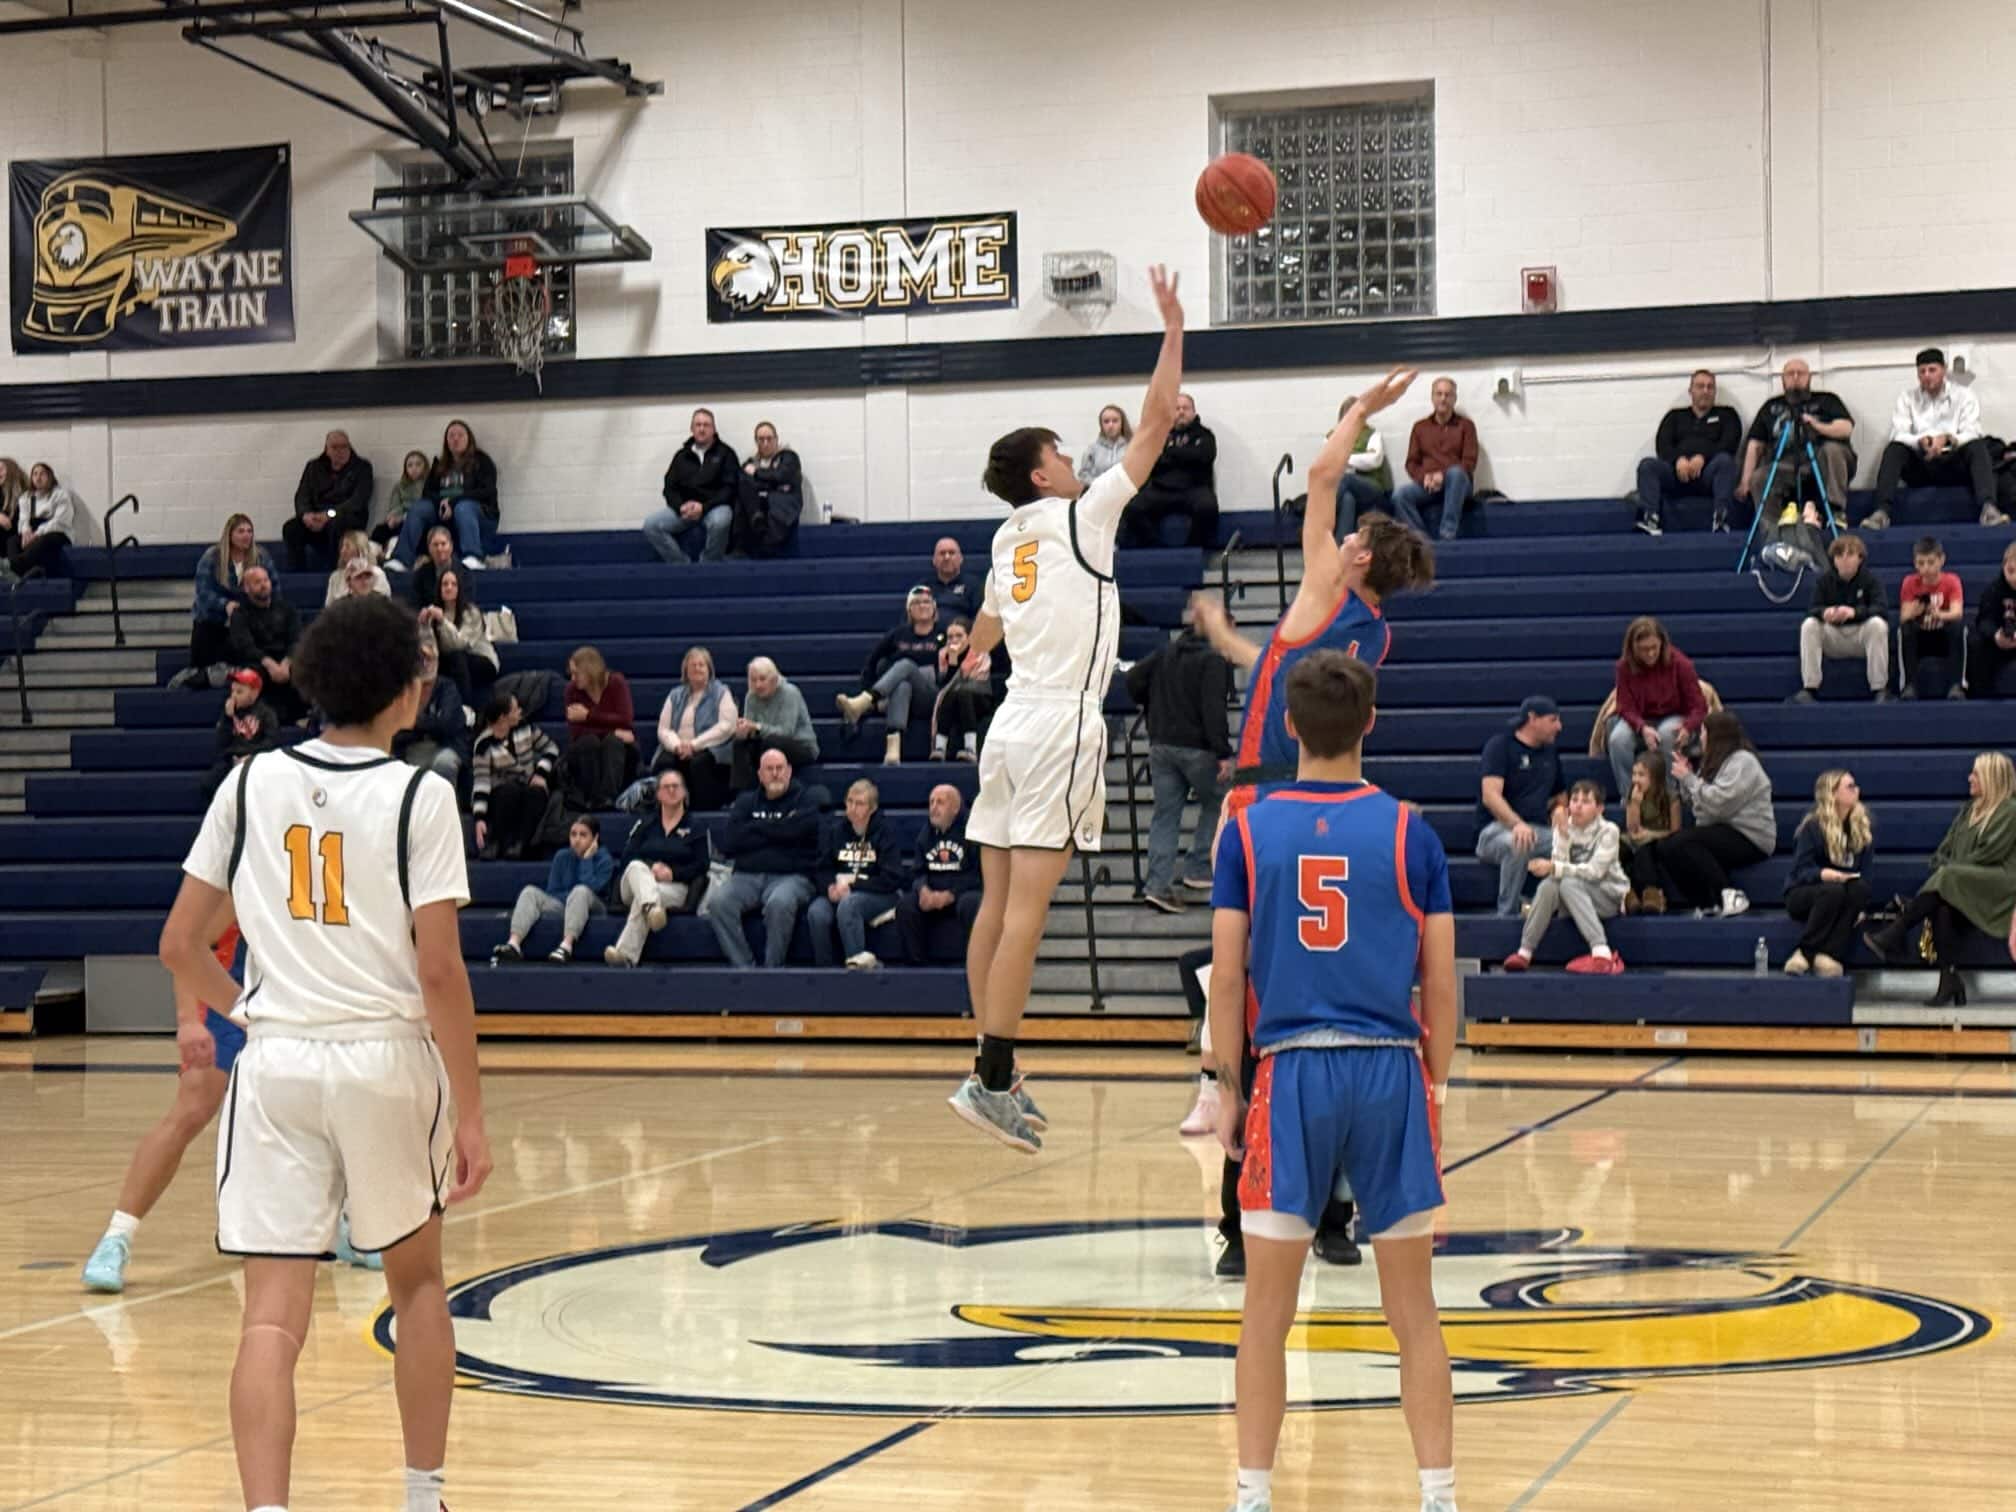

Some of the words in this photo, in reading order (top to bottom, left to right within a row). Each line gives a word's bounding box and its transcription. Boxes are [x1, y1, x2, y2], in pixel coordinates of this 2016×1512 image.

[133, 249, 284, 293] WAYNE
[762, 219, 1008, 311] HOME
[151, 290, 267, 333] TRAIN
[1011, 540, 1039, 604] 5
[284, 823, 350, 926] 11
[1298, 855, 1348, 951] 5
